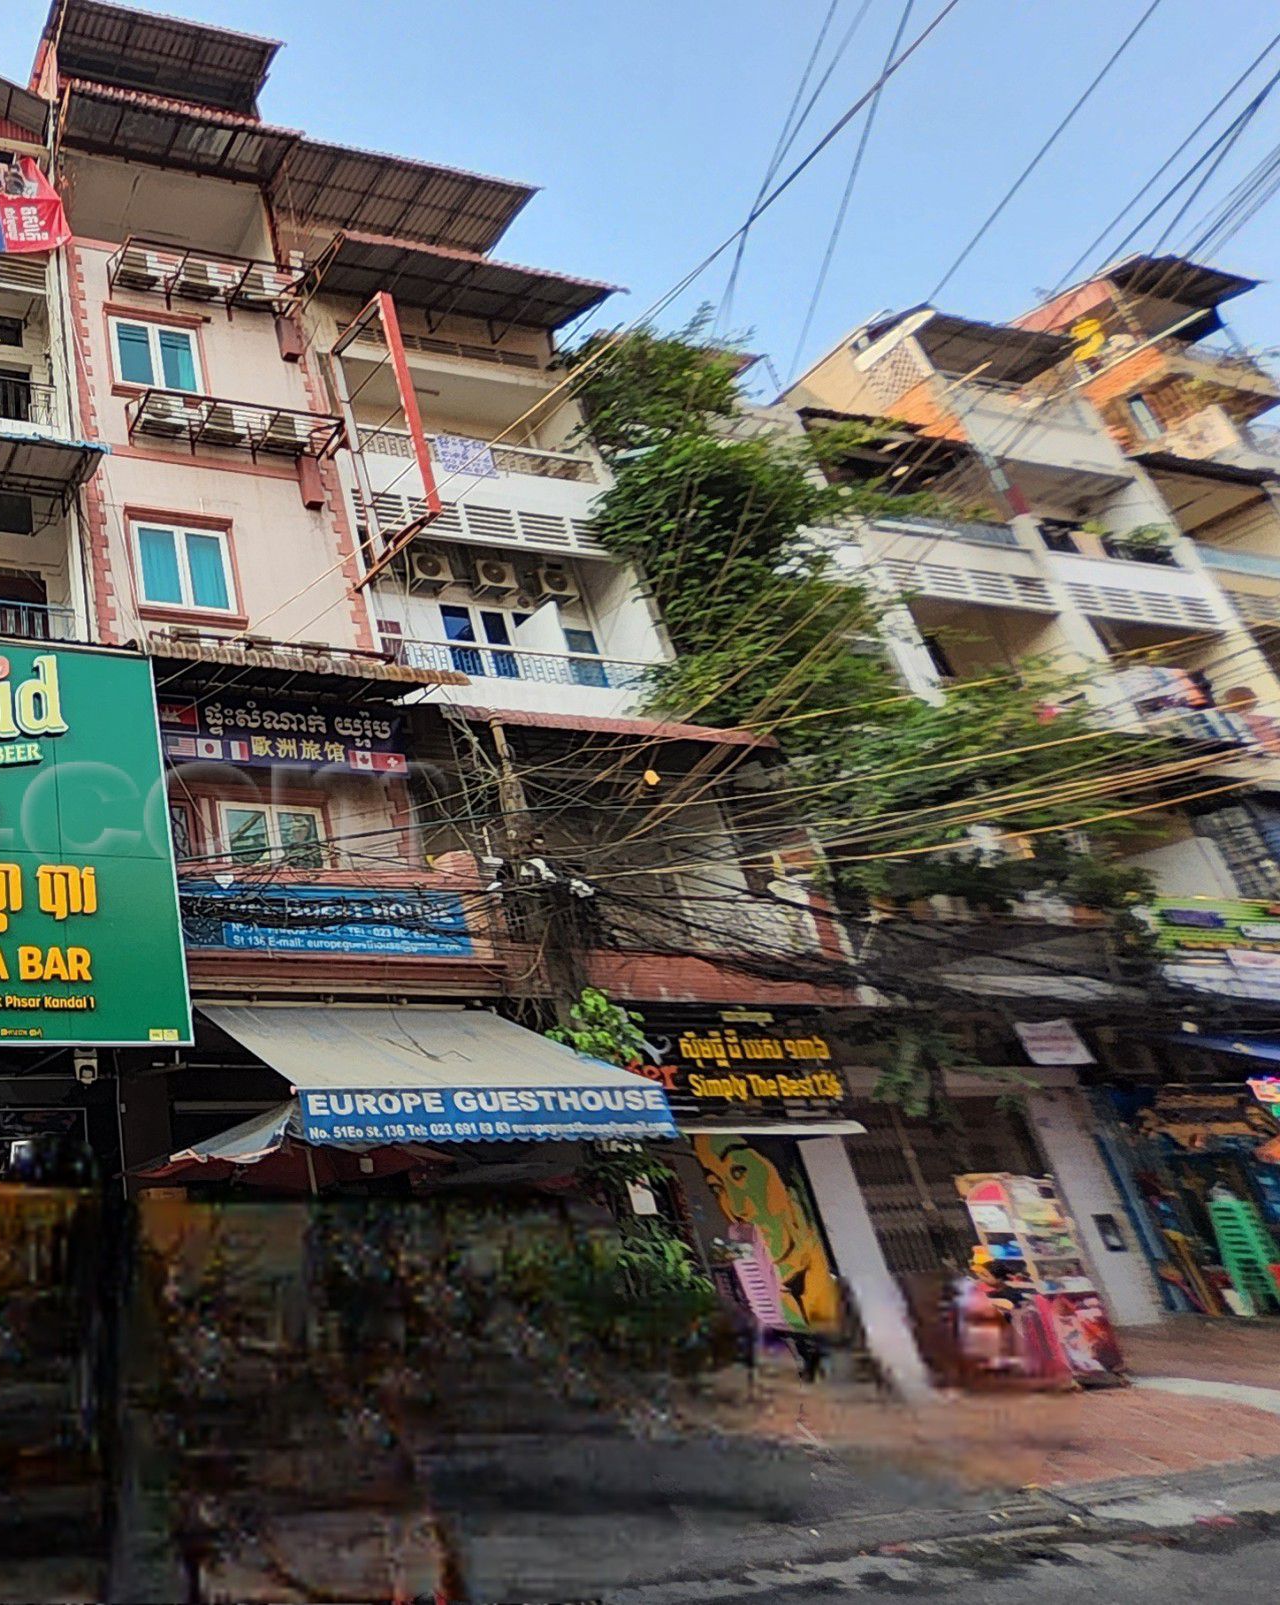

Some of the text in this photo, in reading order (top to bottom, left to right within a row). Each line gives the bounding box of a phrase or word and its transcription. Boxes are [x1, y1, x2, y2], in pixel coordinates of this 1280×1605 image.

[18, 945, 93, 982] BAR
[5, 995, 41, 1009] Phsar
[44, 996, 87, 1009] Kandal
[89, 996, 96, 1009] 1
[687, 1072, 749, 1101] Simply
[746, 1074, 778, 1098] The
[775, 1072, 815, 1098] Best
[307, 1090, 666, 1117] EUROPE GUESTHOUSE
[309, 1126, 331, 1140] No.
[430, 1123, 452, 1136] 023
